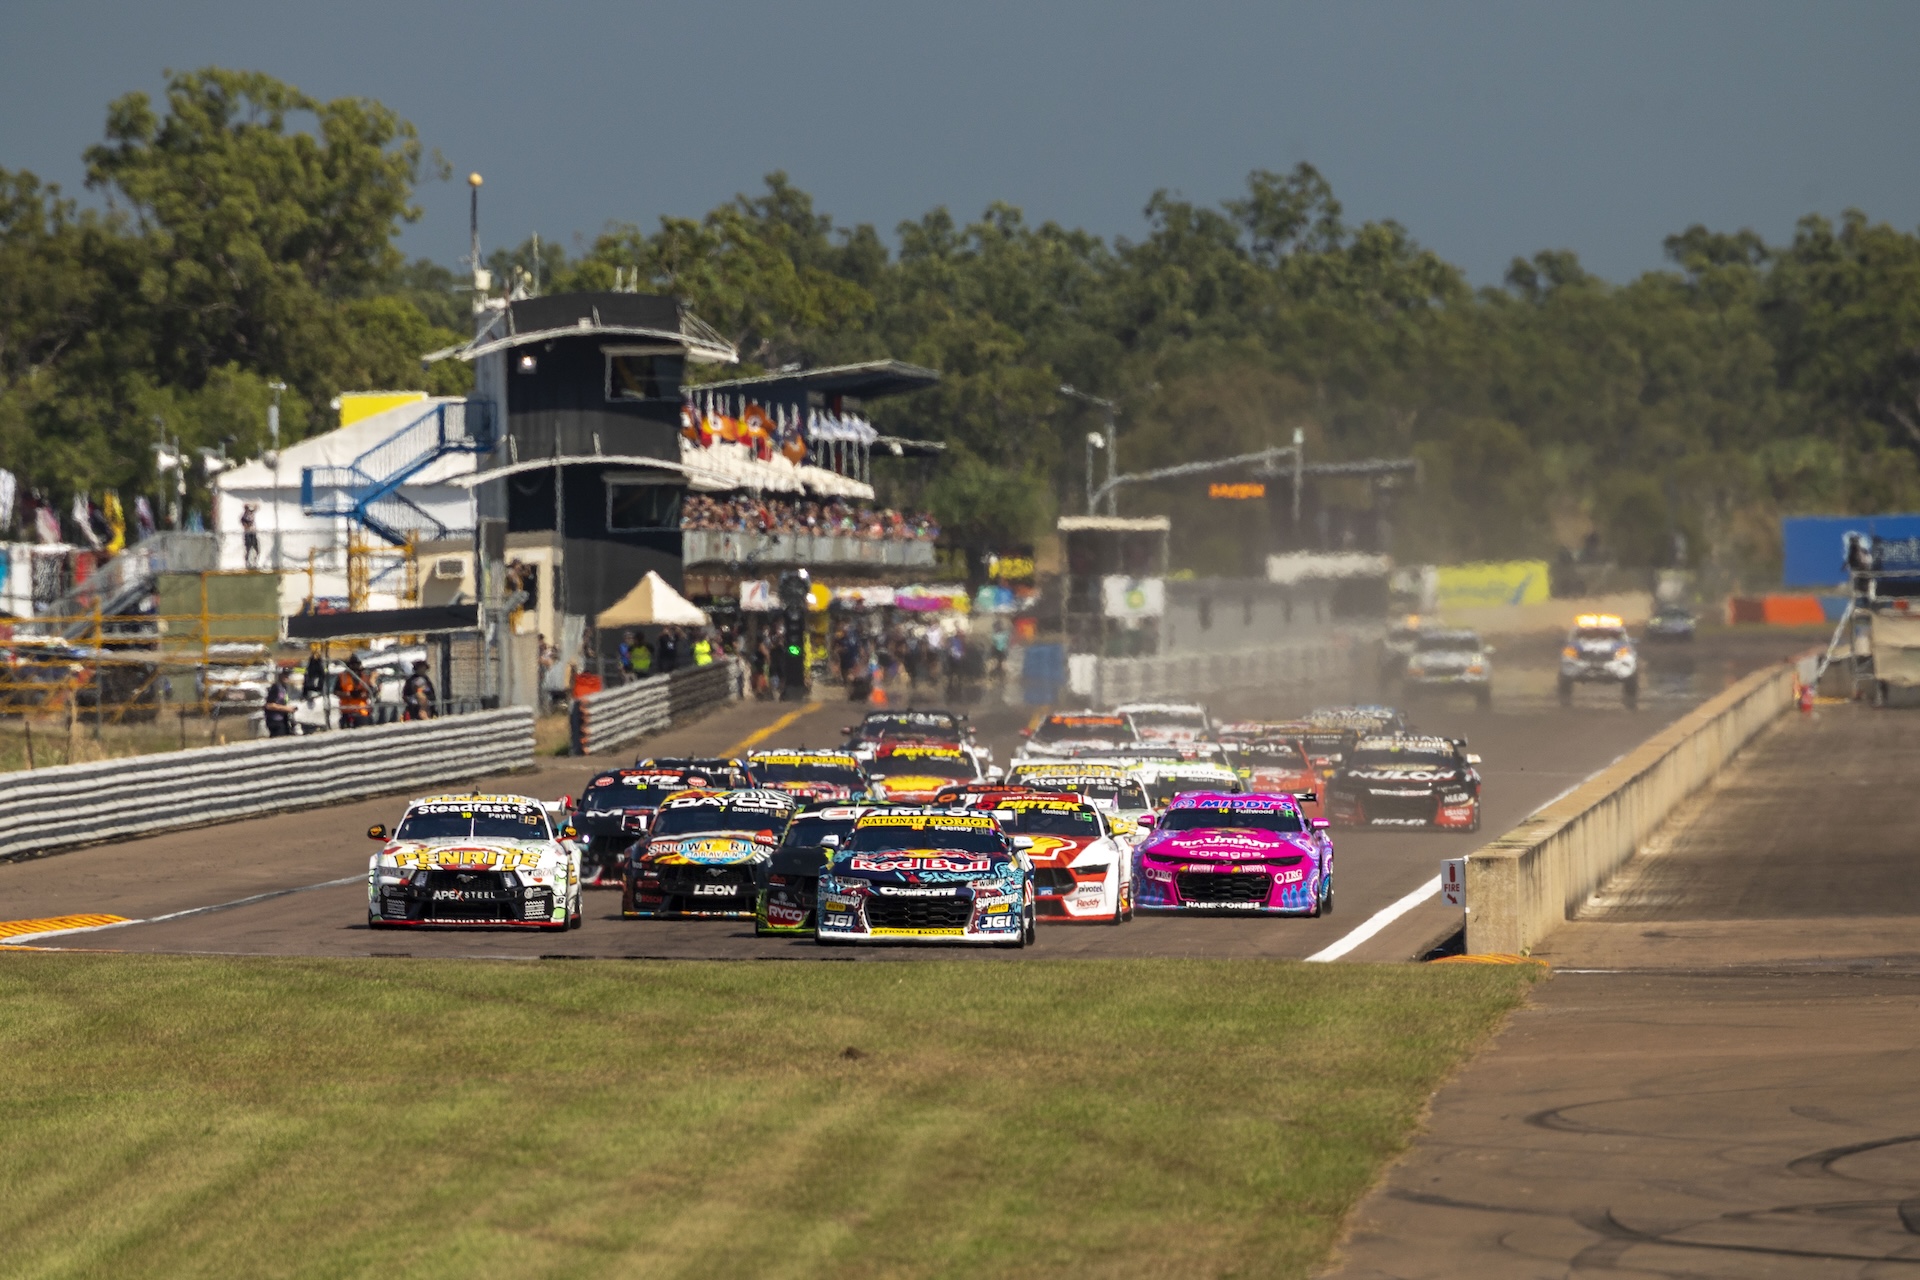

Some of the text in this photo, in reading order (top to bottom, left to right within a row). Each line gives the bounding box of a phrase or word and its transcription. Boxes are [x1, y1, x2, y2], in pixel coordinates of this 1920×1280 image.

[1348, 770, 1456, 780] NULON
[1029, 776, 1110, 786] Steadfast
[670, 797, 786, 809] DAYCO
[997, 800, 1081, 811] PIRTEK
[1201, 800, 1293, 810] MIDDY'S
[418, 803, 511, 815] Steadfast
[865, 808, 989, 818] AMPOL
[862, 818, 993, 827] NATIONAL STORAGE
[647, 842, 714, 856] SNOWY
[394, 851, 542, 869] PENRITE
[684, 851, 748, 859] CARAVANS
[851, 858, 991, 872] Red Bull
[1285, 870, 1302, 880] TRG
[693, 884, 738, 896] LEON
[1444, 884, 1460, 892] FIRE
[433, 888, 496, 902] APEX STEEL
[1076, 898, 1100, 908] Reddy
[768, 905, 802, 921] RYCO
[823, 913, 854, 927] JGI
[981, 915, 1012, 928] JGI
